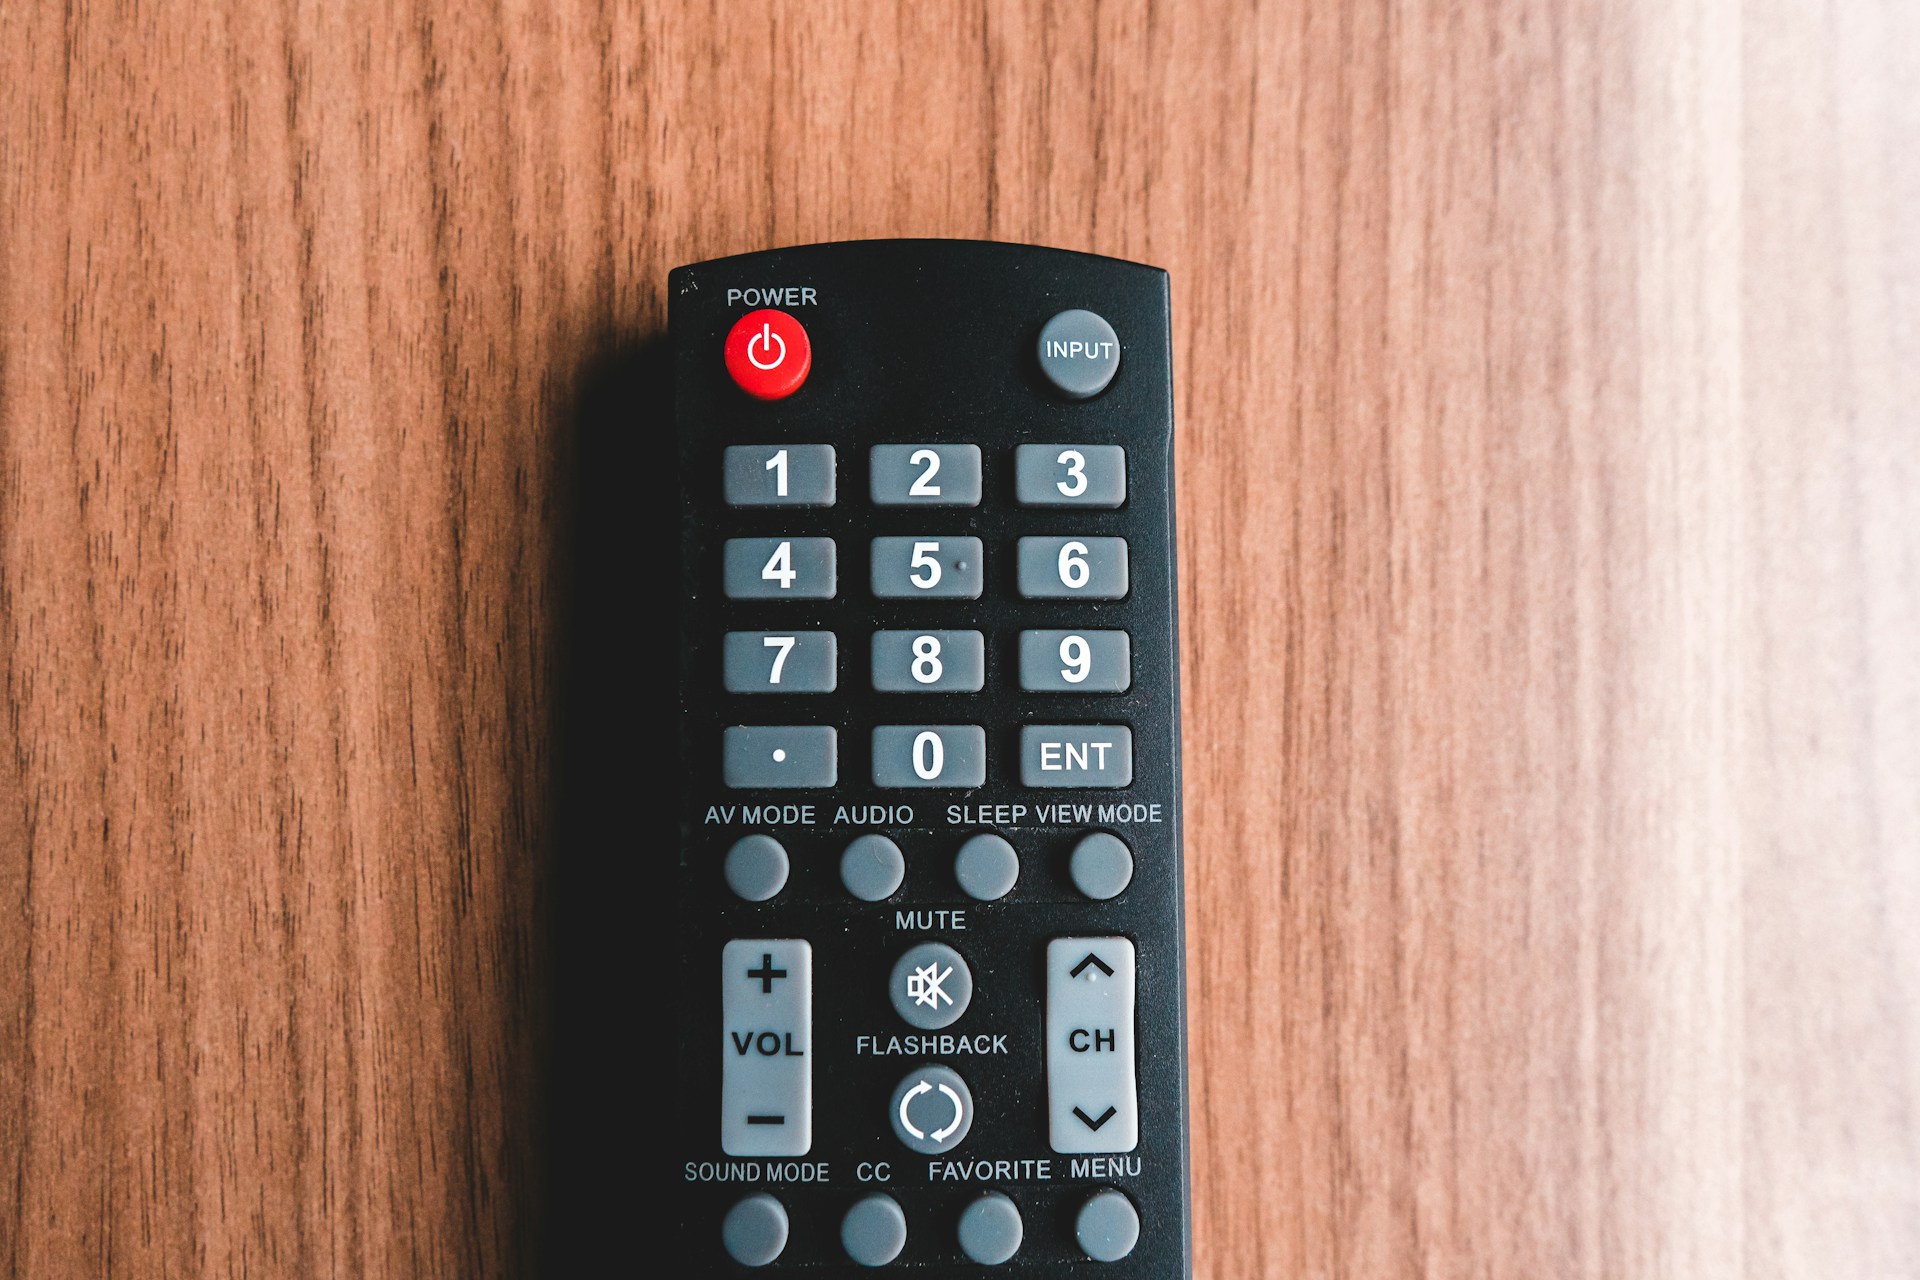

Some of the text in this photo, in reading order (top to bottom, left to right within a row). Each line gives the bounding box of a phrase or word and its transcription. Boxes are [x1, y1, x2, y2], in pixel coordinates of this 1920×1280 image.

[727, 287, 817, 307] POWER
[1046, 341, 1113, 360] INPUT
[765, 449, 788, 497] 1
[909, 449, 941, 496] 2
[1056, 451, 1088, 498] 3
[761, 542, 796, 588] 4
[909, 542, 941, 589] 5
[1058, 542, 1090, 588] 6
[763, 637, 795, 684] 7
[911, 635, 943, 683] 8
[1059, 635, 1092, 683] 9
[912, 731, 944, 780] 0
[1040, 742, 1112, 771] ENT
[705, 806, 816, 825] AV MODE
[833, 805, 914, 825] AUDIO
[946, 804, 1027, 824] SLEEP
[1036, 804, 1162, 823] VIEW MODE
[895, 911, 966, 930] MUTE
[731, 1032, 804, 1056] VOL
[857, 1035, 1009, 1055] FLASHBACK
[1069, 1028, 1116, 1052] CH
[684, 1162, 830, 1182] SOUND MODE
[857, 1162, 891, 1182] CC
[929, 1160, 1052, 1181] FAVORITE
[1071, 1158, 1142, 1178] MENU
